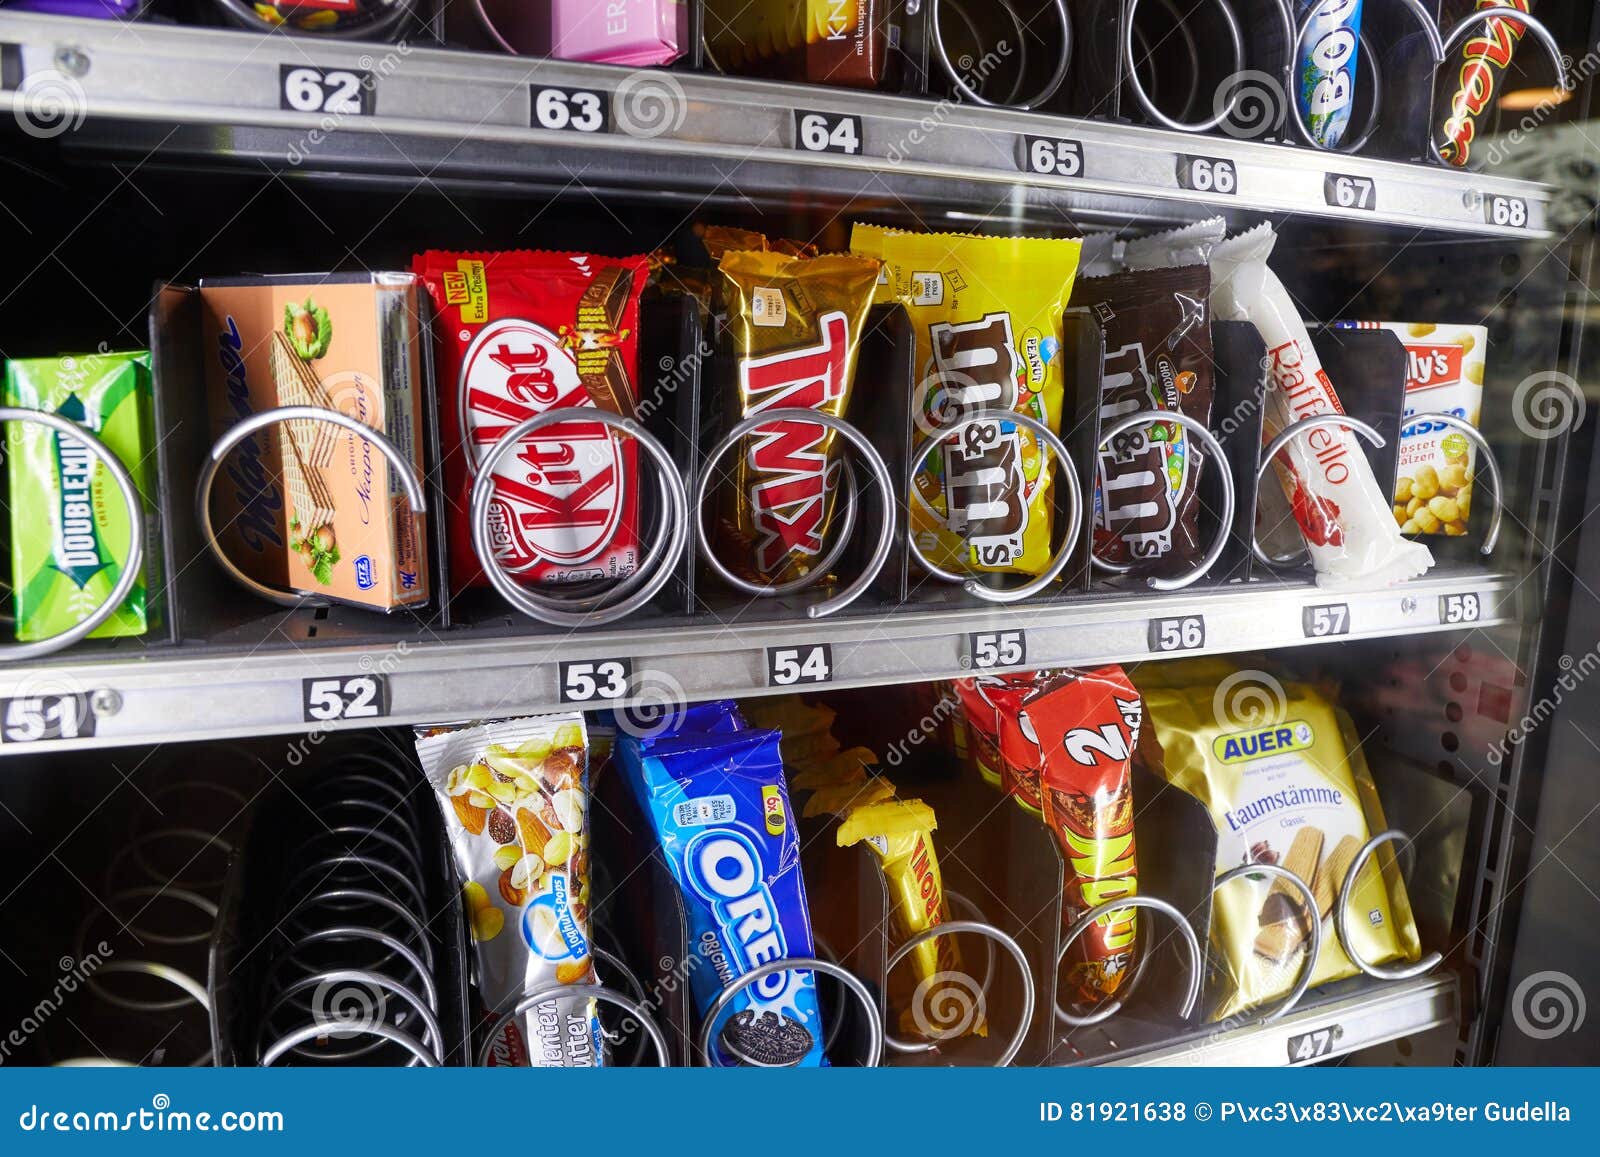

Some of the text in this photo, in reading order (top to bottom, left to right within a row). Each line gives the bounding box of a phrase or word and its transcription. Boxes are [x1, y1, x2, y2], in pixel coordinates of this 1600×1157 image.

[855, 40, 864, 56] mit
[285, 69, 362, 114] 62
[536, 89, 603, 132] 63
[801, 115, 859, 155] 64
[1030, 140, 1081, 175] 65
[1192, 158, 1234, 194] 66
[1335, 176, 1373, 209] 67
[1493, 197, 1526, 228] 68
[449, 271, 466, 301] NEW
[474, 295, 485, 320] Extra
[1026, 337, 1042, 383] PEANUT
[1157, 360, 1179, 408] CHOCOLATE
[356, 561, 368, 586] UTZ
[1312, 605, 1348, 635] 57
[1447, 593, 1479, 623] 58
[975, 632, 1023, 666] 55
[1160, 617, 1201, 649] 56
[565, 662, 627, 699] 53
[774, 647, 829, 685] 54
[309, 678, 377, 720] 52
[6, 697, 79, 741] 51
[1063, 727, 1131, 766] 2
[1223, 728, 1293, 760] AUER
[766, 796, 781, 813] 6x
[701, 838, 789, 999] OREO
[701, 931, 736, 989] ORIGINA
[1296, 1030, 1331, 1059] 47
